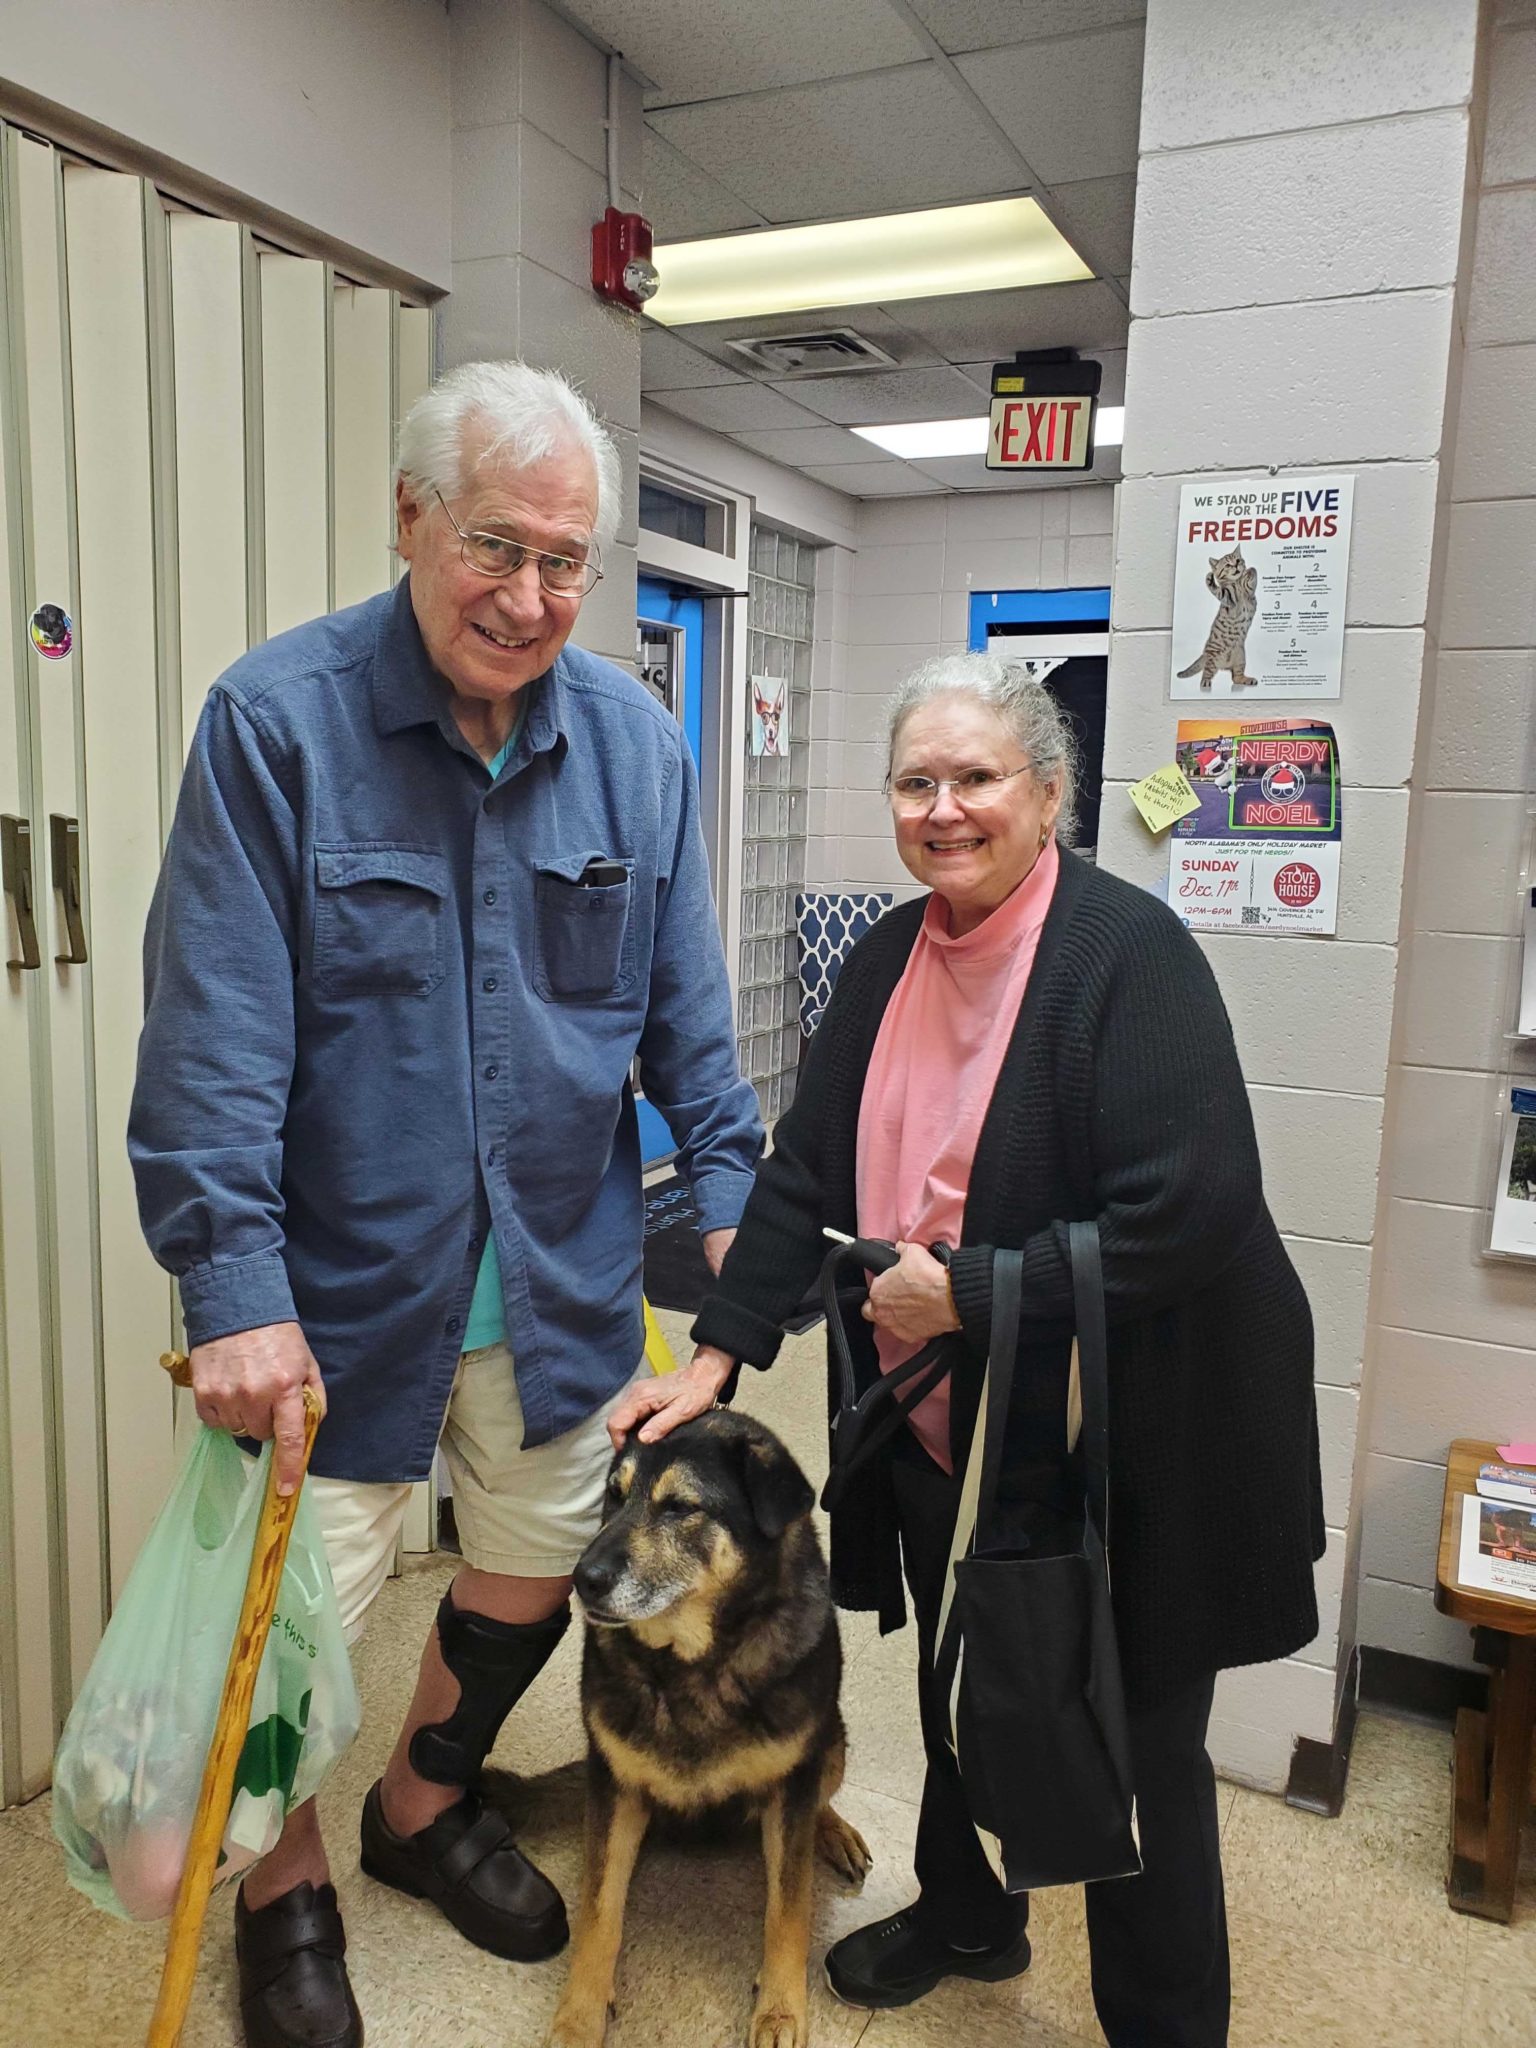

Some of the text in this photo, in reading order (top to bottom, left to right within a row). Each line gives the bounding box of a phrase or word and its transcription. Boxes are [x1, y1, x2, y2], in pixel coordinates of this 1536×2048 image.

[1001, 402, 1082, 462] EXIT
[1194, 492, 1278, 506] WE STAND UP
[1280, 489, 1340, 513] FIVE
[1227, 504, 1277, 516] FOR THE
[1188, 514, 1338, 543] FREEDOMS
[1277, 564, 1281, 573] 1
[1313, 563, 1320, 572] 2
[1274, 601, 1280, 609] 3
[1310, 600, 1318, 608] 4
[1290, 638, 1296, 647] 5
[1240, 742, 1328, 762] NERDY
[1246, 804, 1320, 824] NOEL
[1182, 860, 1239, 872] SUNDAY
[1279, 870, 1316, 884] STOVE
[1179, 877, 1239, 897] Dec. 11th
[1279, 884, 1315, 898] HOUSE
[1184, 907, 1232, 915] 12PM-6PM
